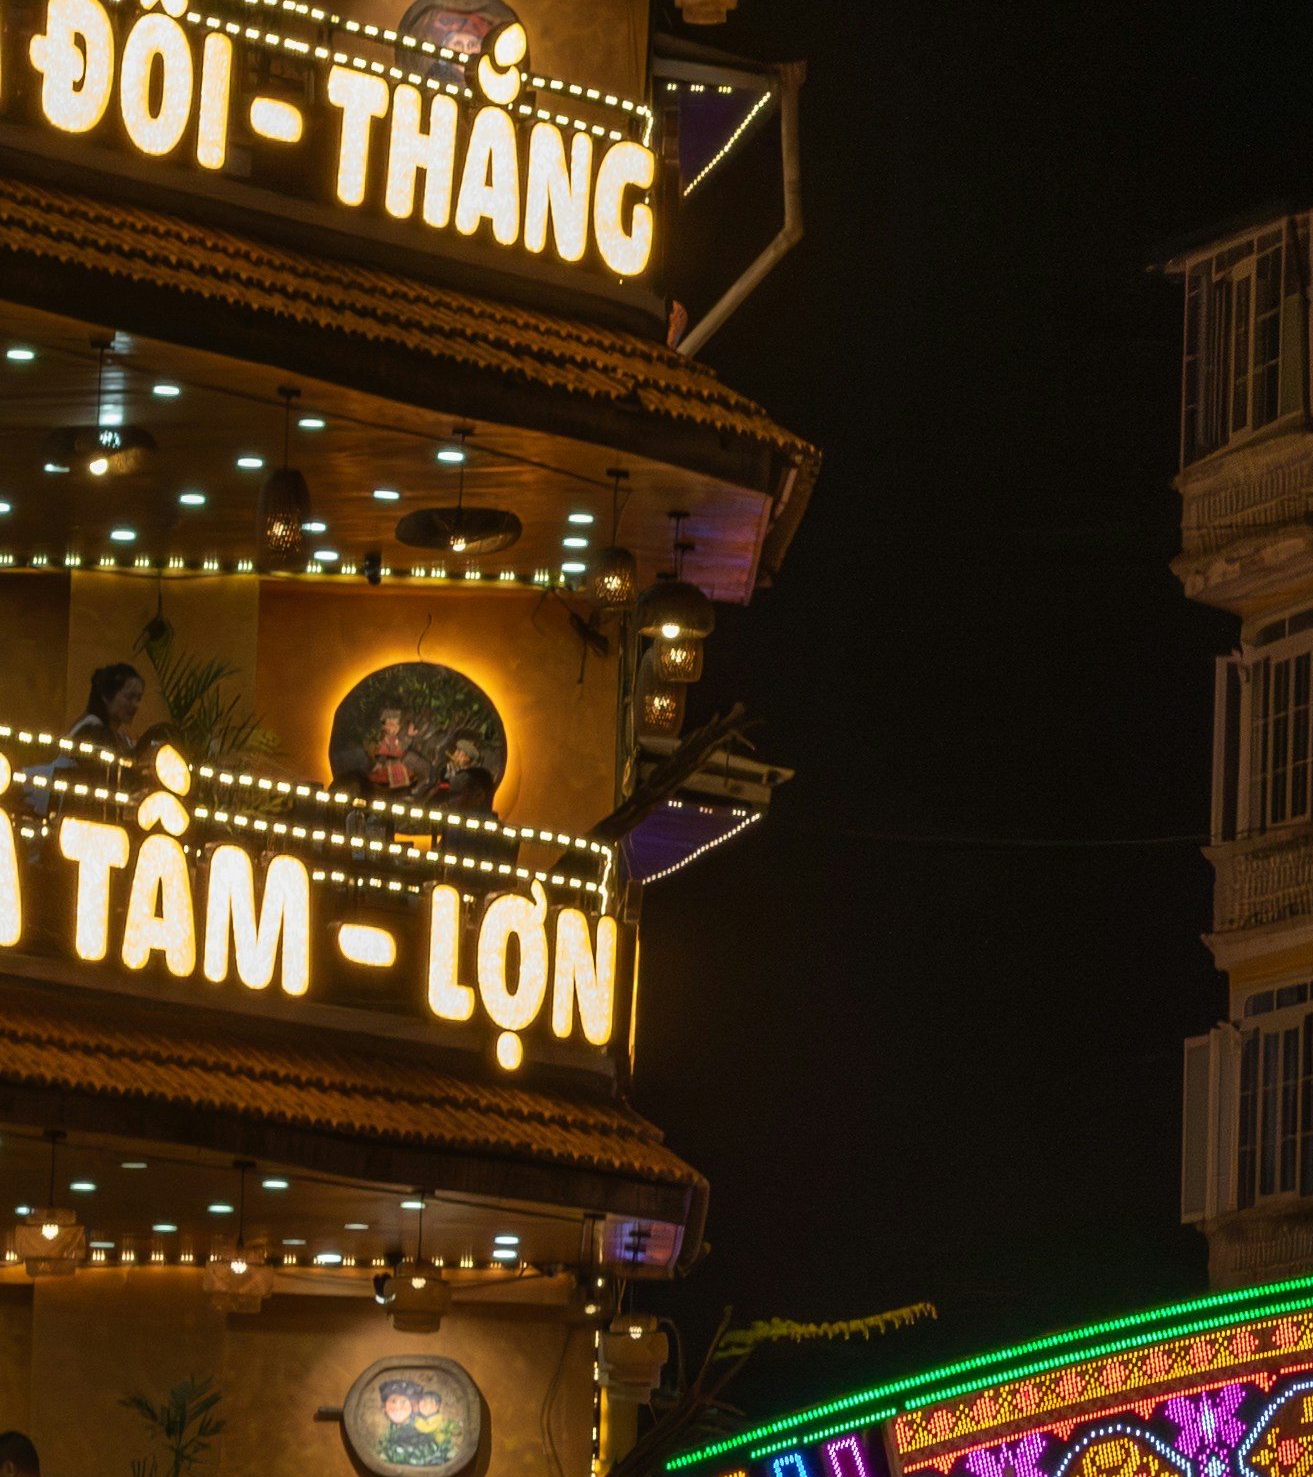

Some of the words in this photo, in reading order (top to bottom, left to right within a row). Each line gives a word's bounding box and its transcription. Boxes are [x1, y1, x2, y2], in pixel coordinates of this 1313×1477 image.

[327, 22, 656, 276] THẮNG
[59, 744, 310, 996] TẦM
[427, 878, 618, 1071] LỢN
